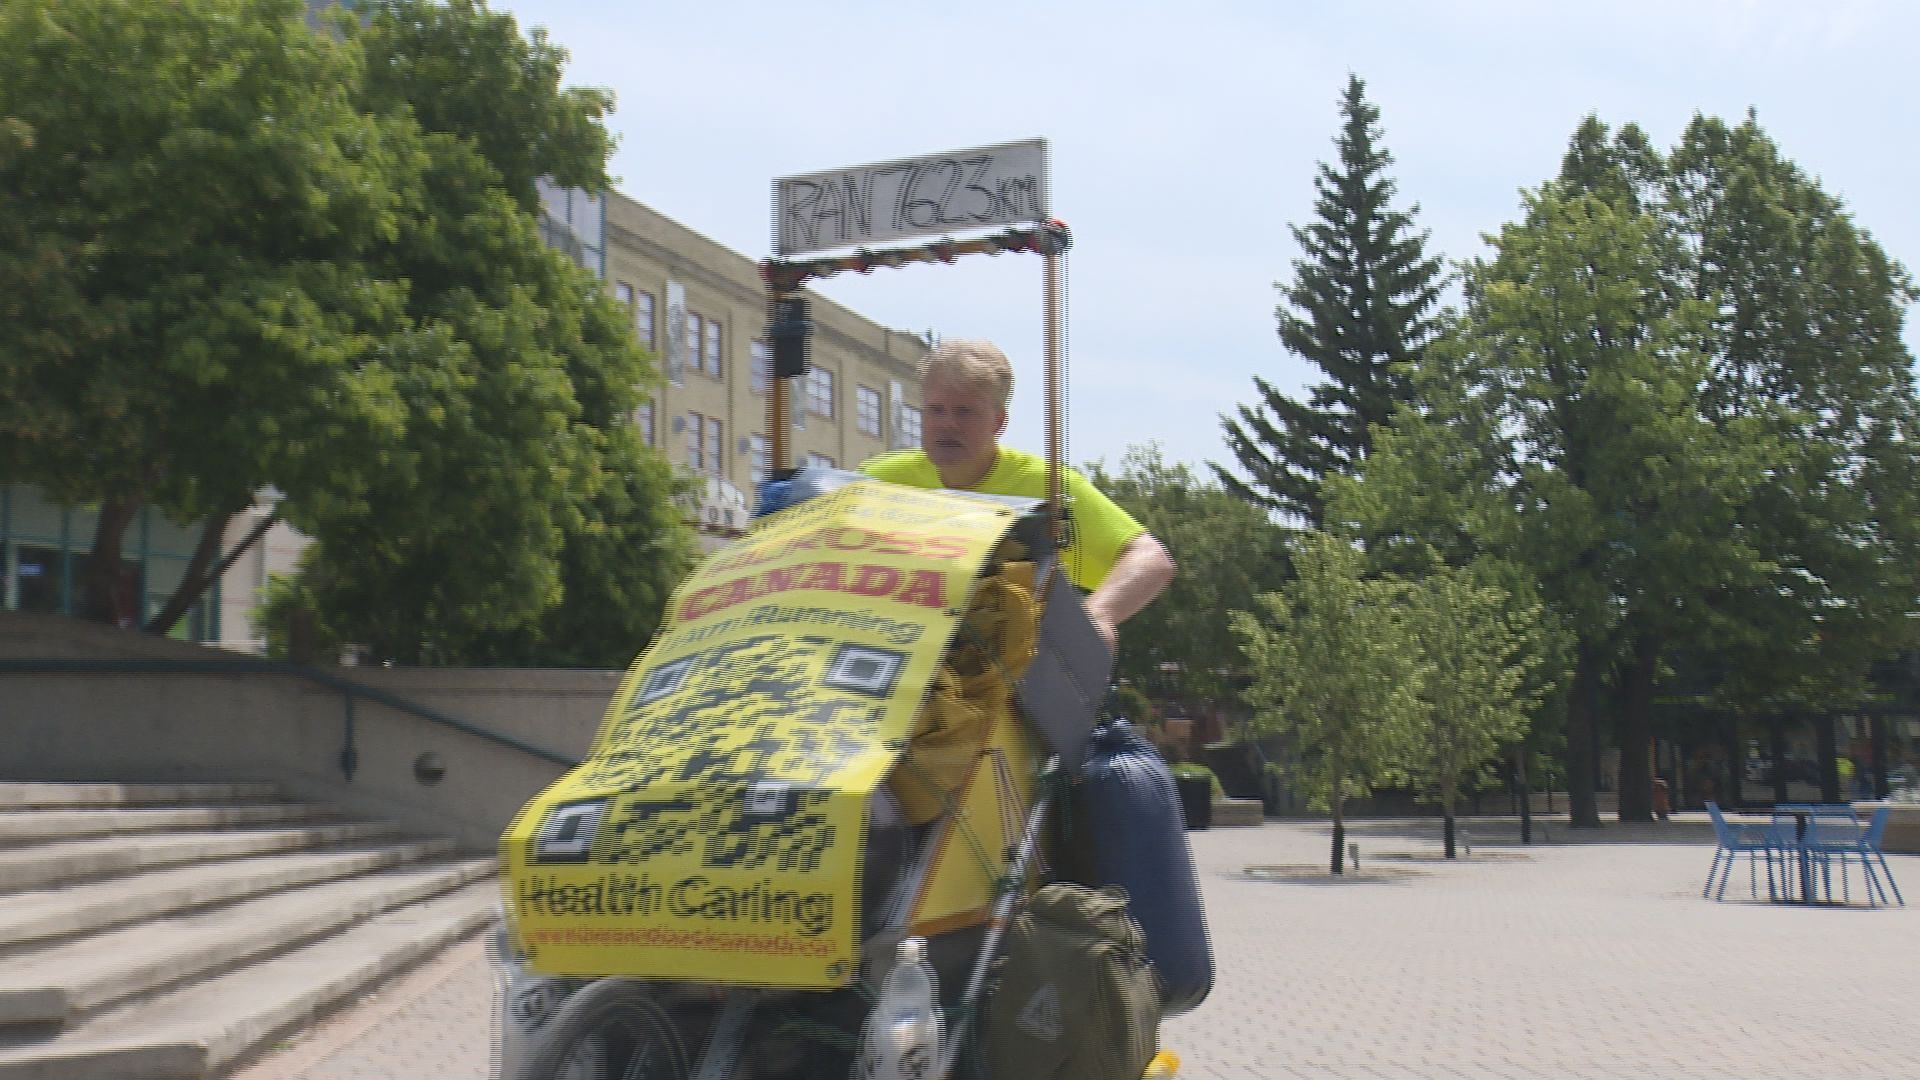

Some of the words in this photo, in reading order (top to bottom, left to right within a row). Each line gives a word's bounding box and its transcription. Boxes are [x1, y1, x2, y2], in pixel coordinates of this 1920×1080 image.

[785, 171, 872, 249] RAN
[702, 527, 971, 580] ACROSS
[679, 561, 950, 622] CANADA
[741, 604, 928, 645] Running
[519, 873, 663, 917] Health
[667, 875, 835, 937] Caring
[525, 924, 837, 958] www.thereandbackcanada.ca
